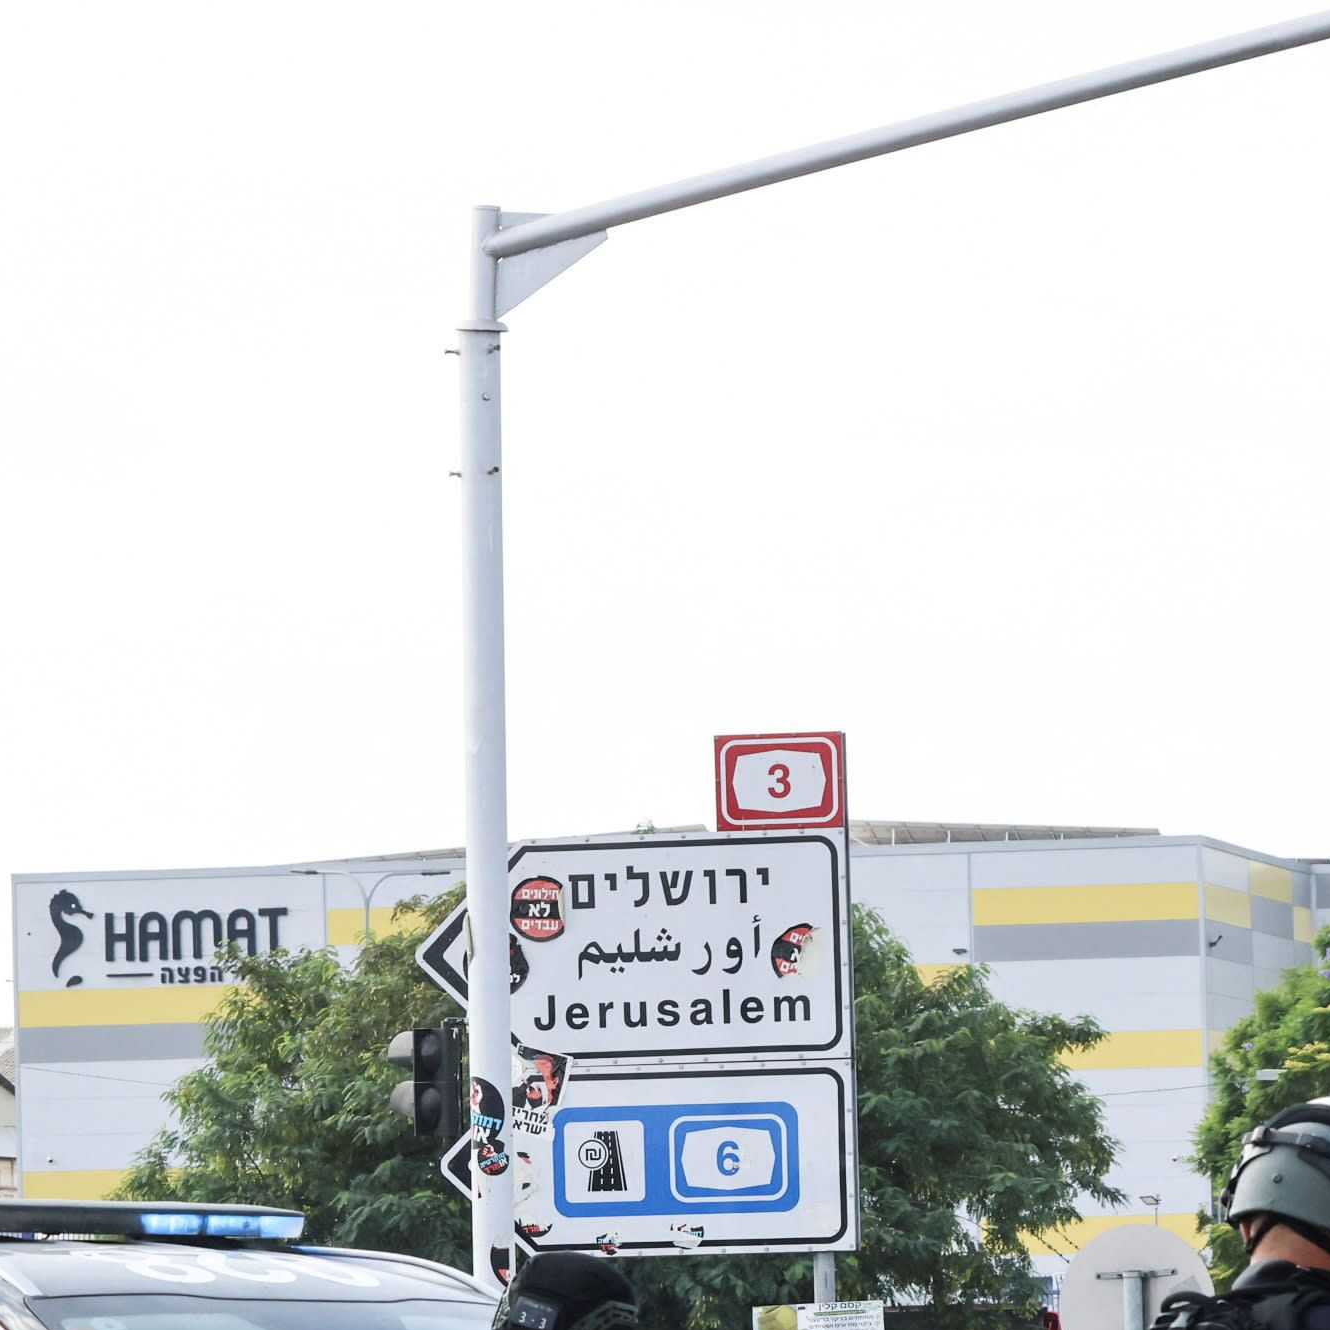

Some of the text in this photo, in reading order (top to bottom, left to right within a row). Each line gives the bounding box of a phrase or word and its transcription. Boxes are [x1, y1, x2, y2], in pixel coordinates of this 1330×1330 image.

[767, 763, 791, 799] 3
[568, 865, 769, 909] ירושלים
[521, 920, 559, 930] עבדים
[529, 902, 550, 917] לא
[105, 907, 288, 962] HAMAT
[160, 966, 223, 984] הפצה
[534, 989, 812, 1032] Jerusalem
[716, 1140, 740, 1176] 6
